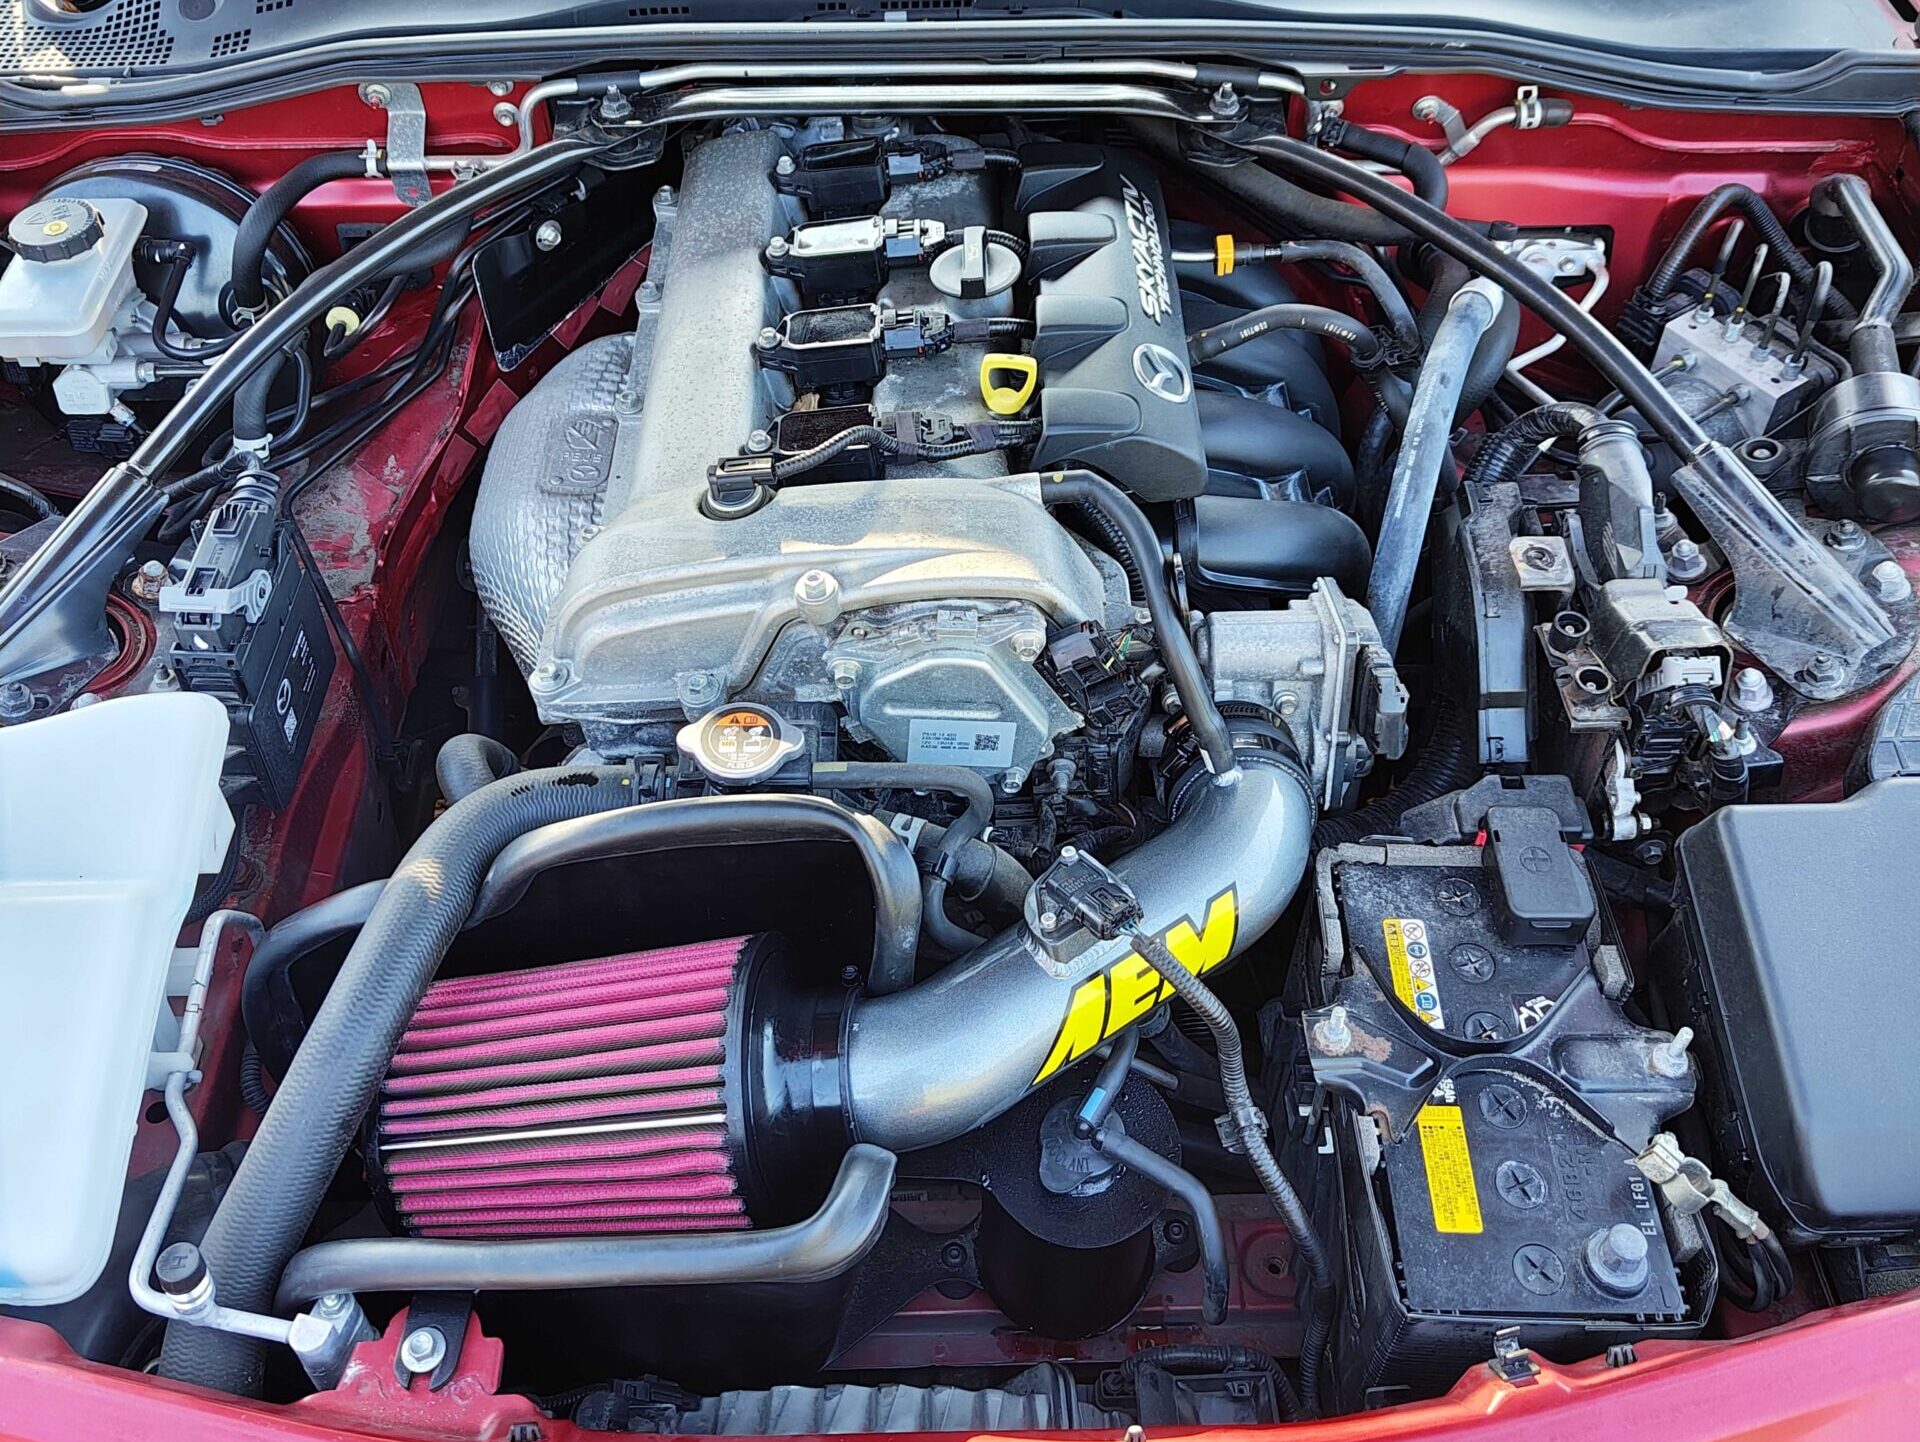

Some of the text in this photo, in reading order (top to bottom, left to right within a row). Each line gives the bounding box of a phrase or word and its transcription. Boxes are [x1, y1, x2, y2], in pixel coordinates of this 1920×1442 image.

[1120, 173, 1161, 325] SKYACTIV
[1140, 191, 1172, 315] TECHNOLOGY
[1030, 886, 1238, 1087] AEM
